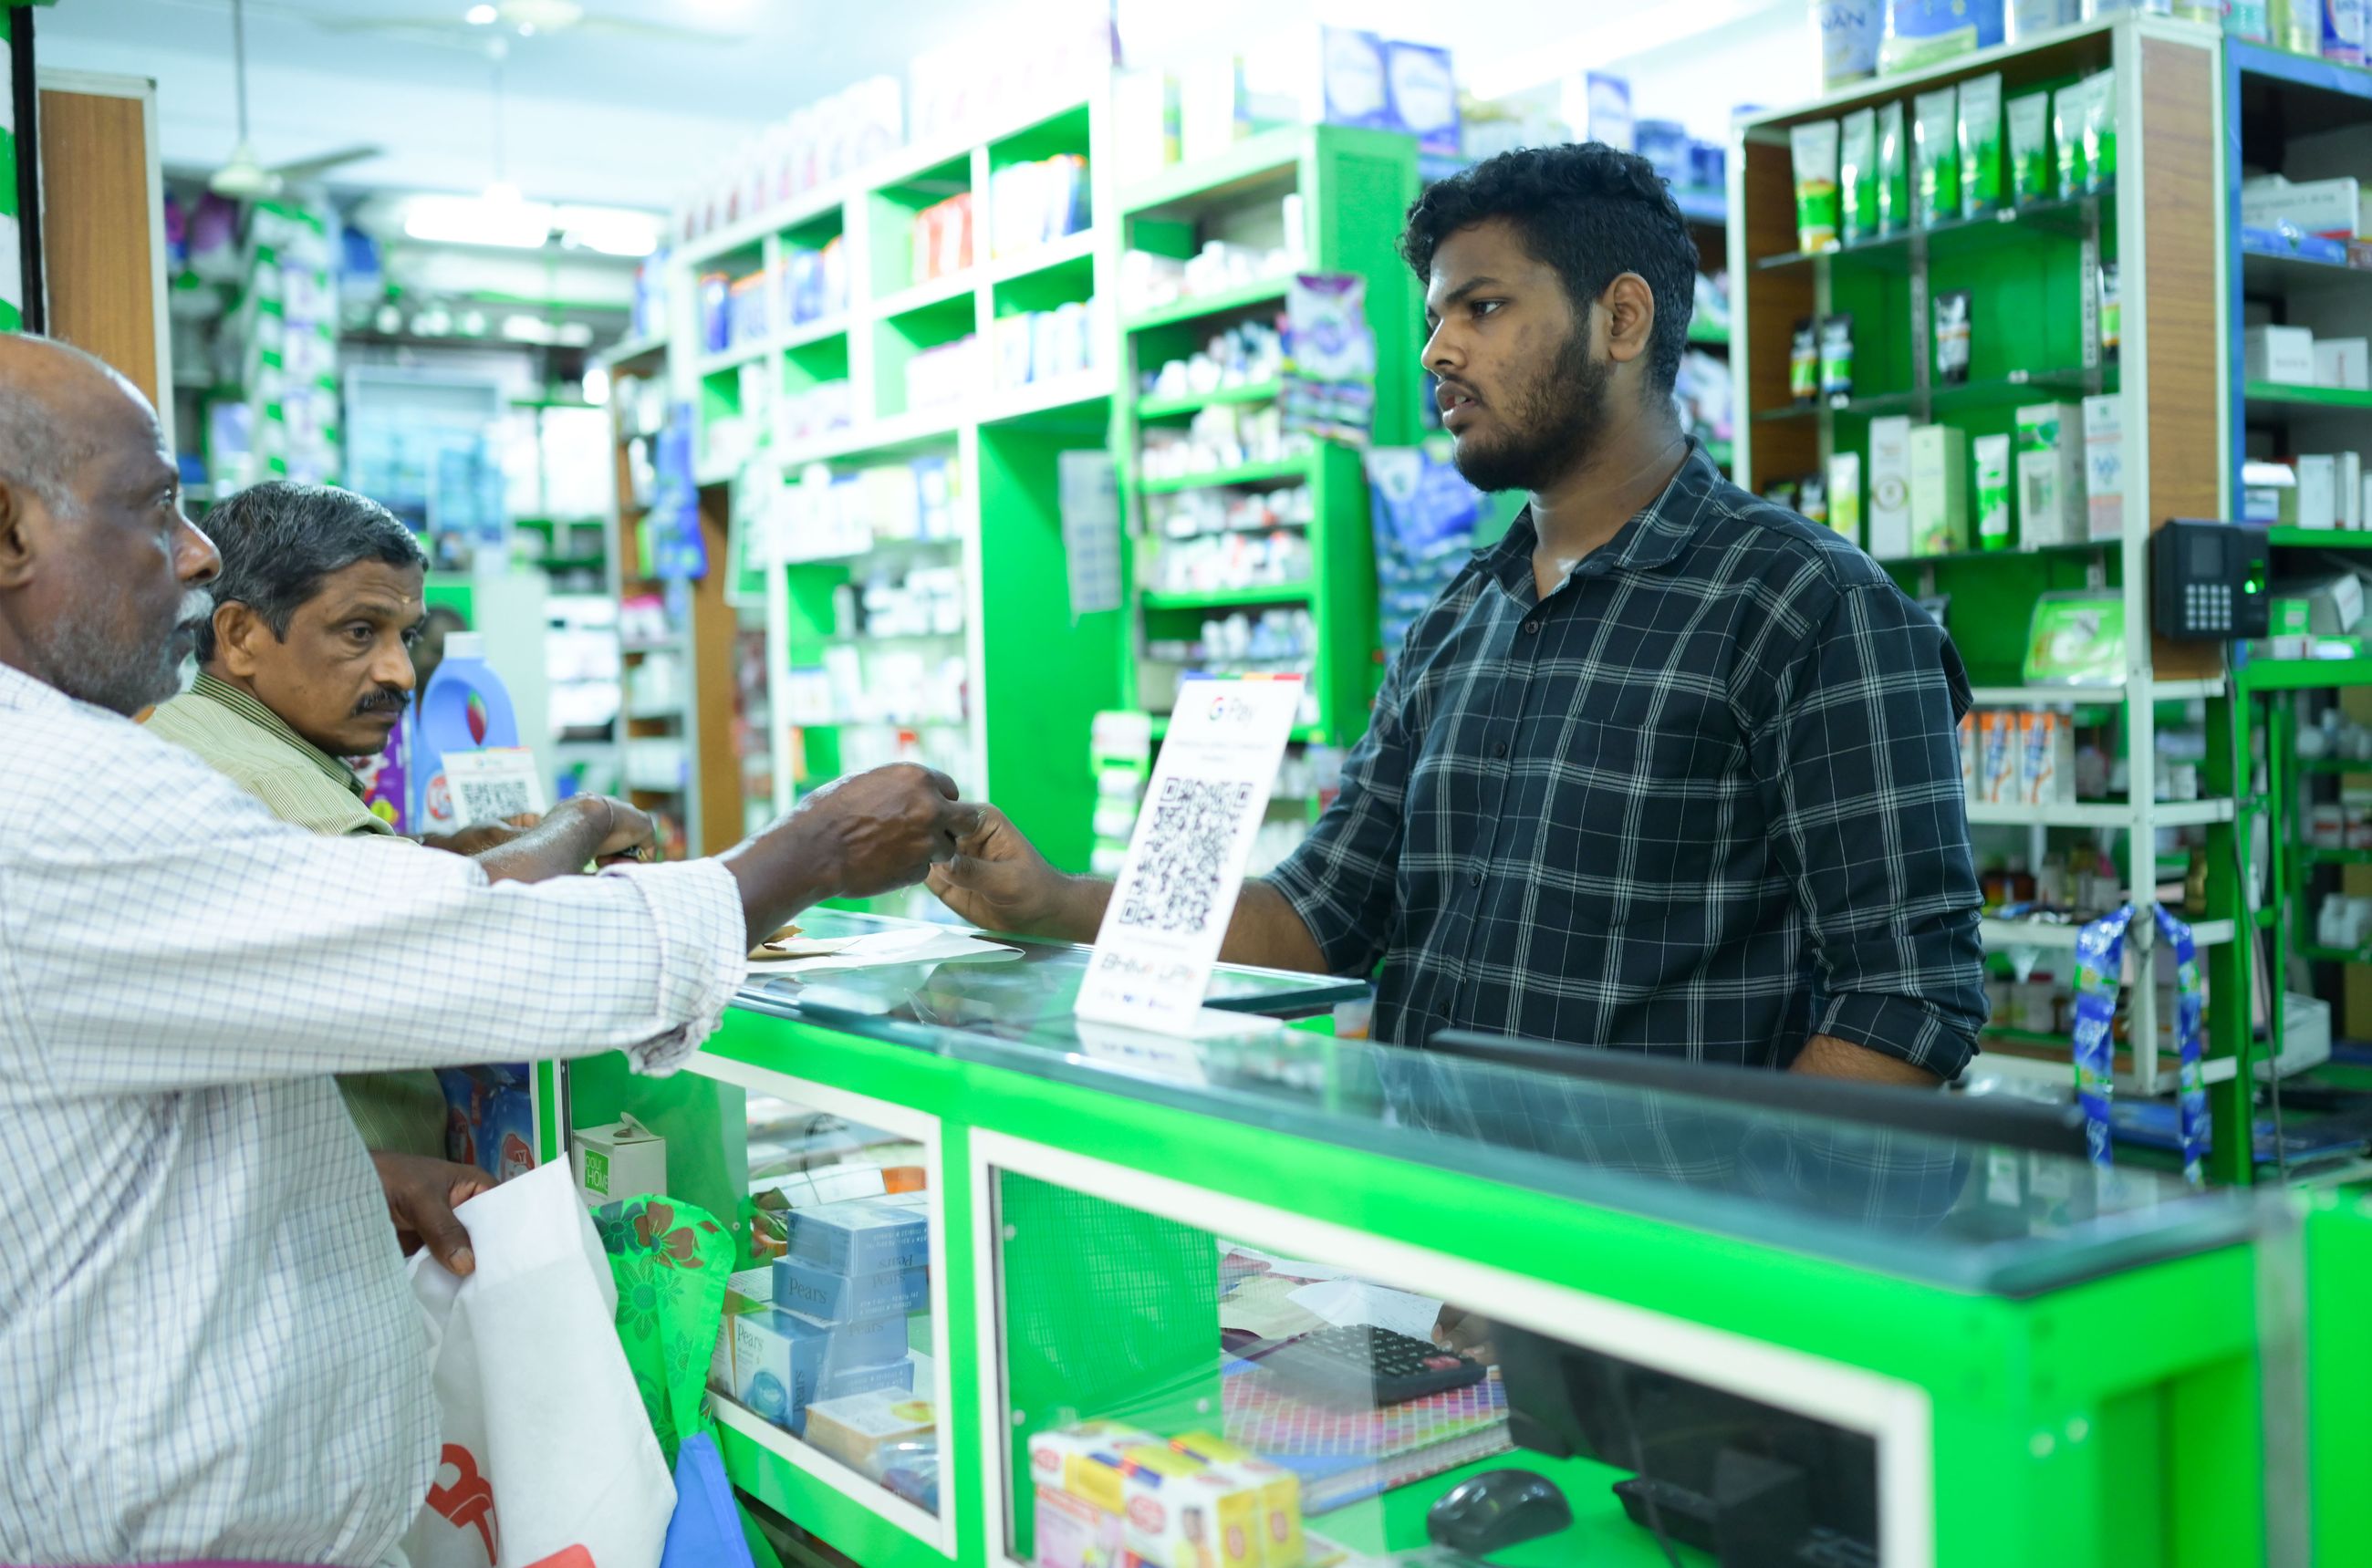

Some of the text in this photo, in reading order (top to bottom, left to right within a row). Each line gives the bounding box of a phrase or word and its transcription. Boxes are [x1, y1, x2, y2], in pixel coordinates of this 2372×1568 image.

[587, 1168, 609, 1191] HOME
[879, 1254, 913, 1269] Pears
[787, 1277, 827, 1305] Pears
[736, 1323, 765, 1352] Pears
